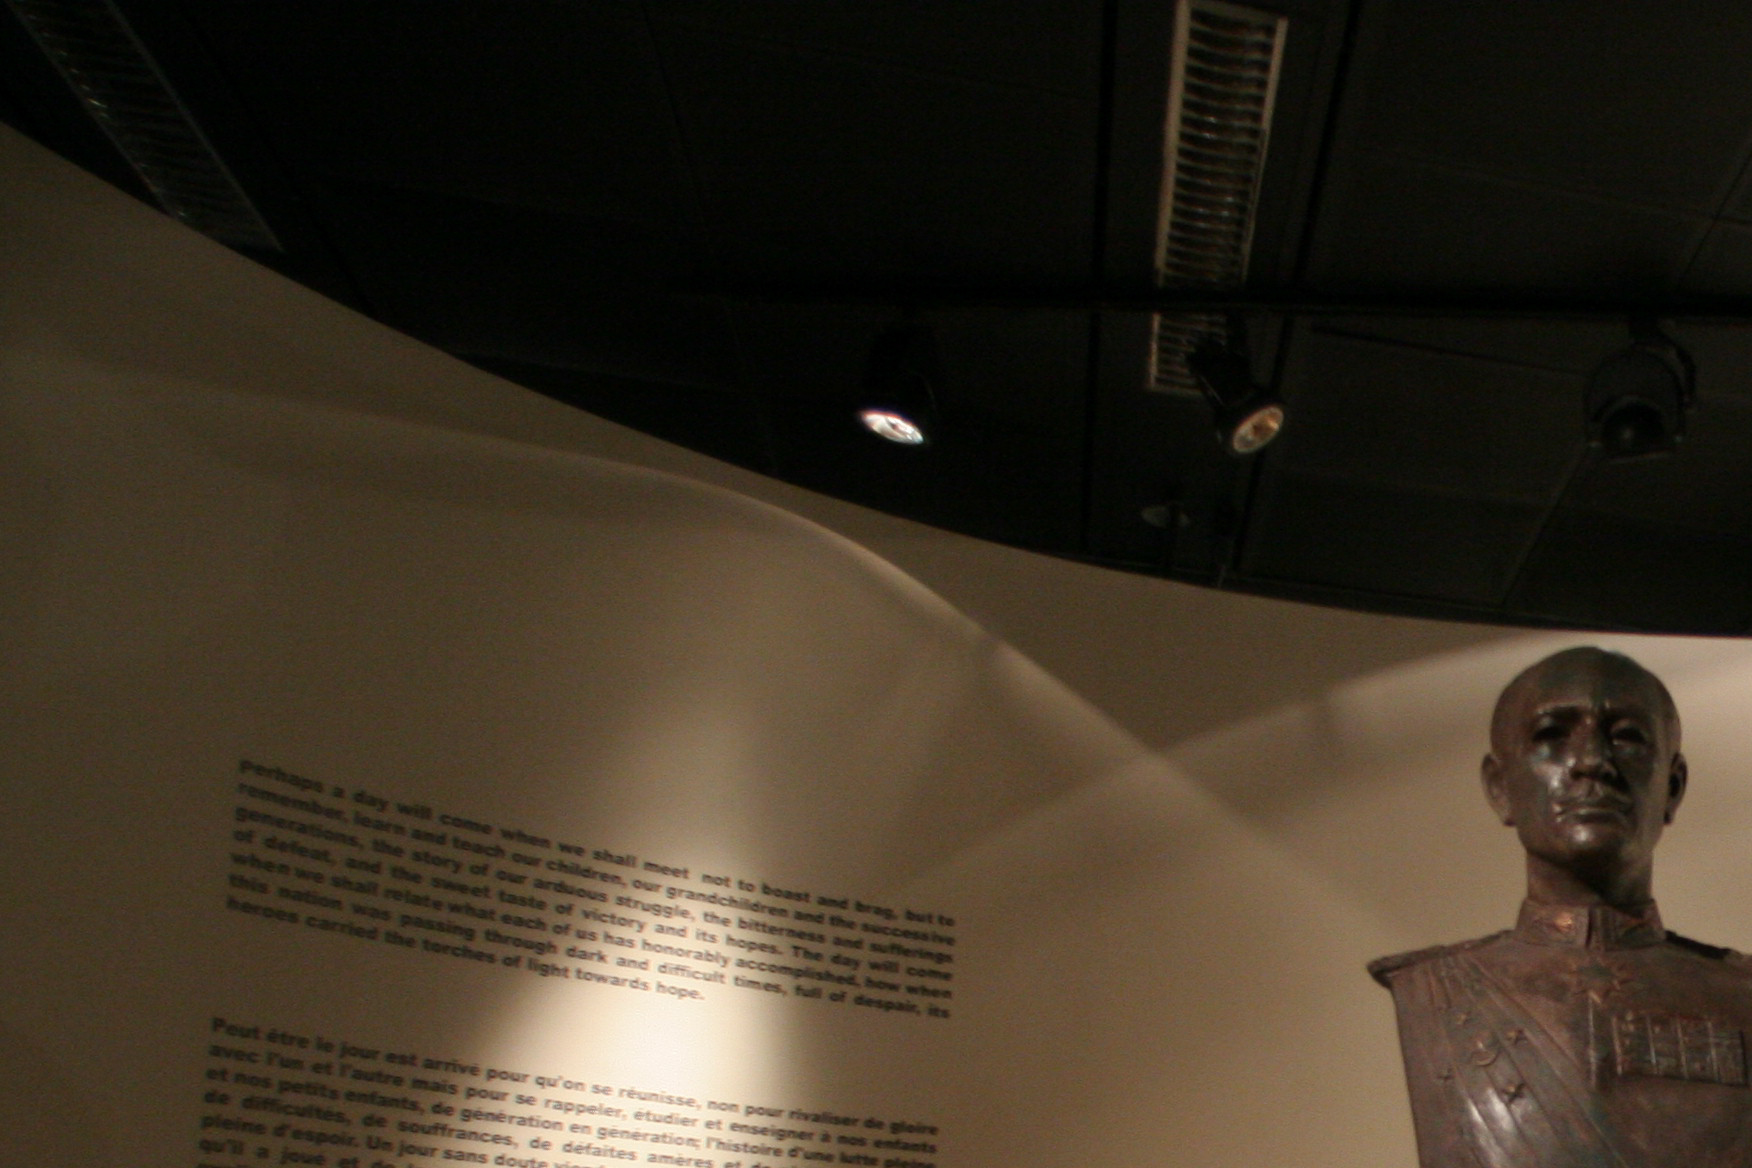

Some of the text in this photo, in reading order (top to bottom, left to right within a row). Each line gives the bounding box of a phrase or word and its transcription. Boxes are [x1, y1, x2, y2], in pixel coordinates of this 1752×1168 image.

[240, 759, 324, 794] Perhaps
[333, 786, 344, 799] a
[354, 791, 388, 812] day
[398, 802, 432, 819] will
[439, 813, 492, 834] come
[501, 828, 550, 849] when
[559, 842, 584, 856] we
[593, 850, 637, 869] shall
[644, 861, 689, 879] meet
[702, 873, 731, 888] not
[738, 878, 755, 892] to
[762, 881, 810, 902] boast
[818, 895, 848, 910] and
[906, 909, 934, 924] but
[939, 912, 954, 927] to
[354, 812, 405, 836] learn
[412, 828, 448, 846] and
[452, 837, 504, 858] teach
[512, 851, 542, 867] our
[632, 878, 662, 894] our
[666, 884, 788, 918] grandchildren
[794, 909, 824, 924] and
[830, 912, 856, 930] the
[862, 919, 954, 946] successive
[372, 838, 404, 858] the
[412, 848, 461, 873] story
[470, 862, 489, 876] of
[497, 868, 528, 884] our
[534, 876, 608, 902] arduous
[704, 909, 731, 927] the
[738, 916, 826, 944] bitterness
[833, 934, 863, 950] and
[870, 940, 952, 964] sufferings
[209, 1044, 259, 1064] avec
[311, 1059, 332, 1075] et
[411, 1076, 458, 1095] mais
[466, 1084, 509, 1104] pour
[515, 1091, 536, 1106] se
[706, 1117, 722, 1131] et
[730, 1120, 814, 1142] enseigner
[821, 1131, 831, 1144] à
[838, 1134, 866, 1148] nos
[874, 1136, 937, 1154] enfants
[316, 1036, 334, 1052] le
[340, 1042, 380, 1061] jour
[386, 1049, 416, 1067] est
[486, 1066, 529, 1086] pour
[592, 1082, 612, 1096] se
[708, 1099, 739, 1113] non
[745, 1104, 783, 1119] pour
[789, 1107, 859, 1127] rivaliser
[864, 1118, 883, 1131] de
[890, 1121, 938, 1138] gloire
